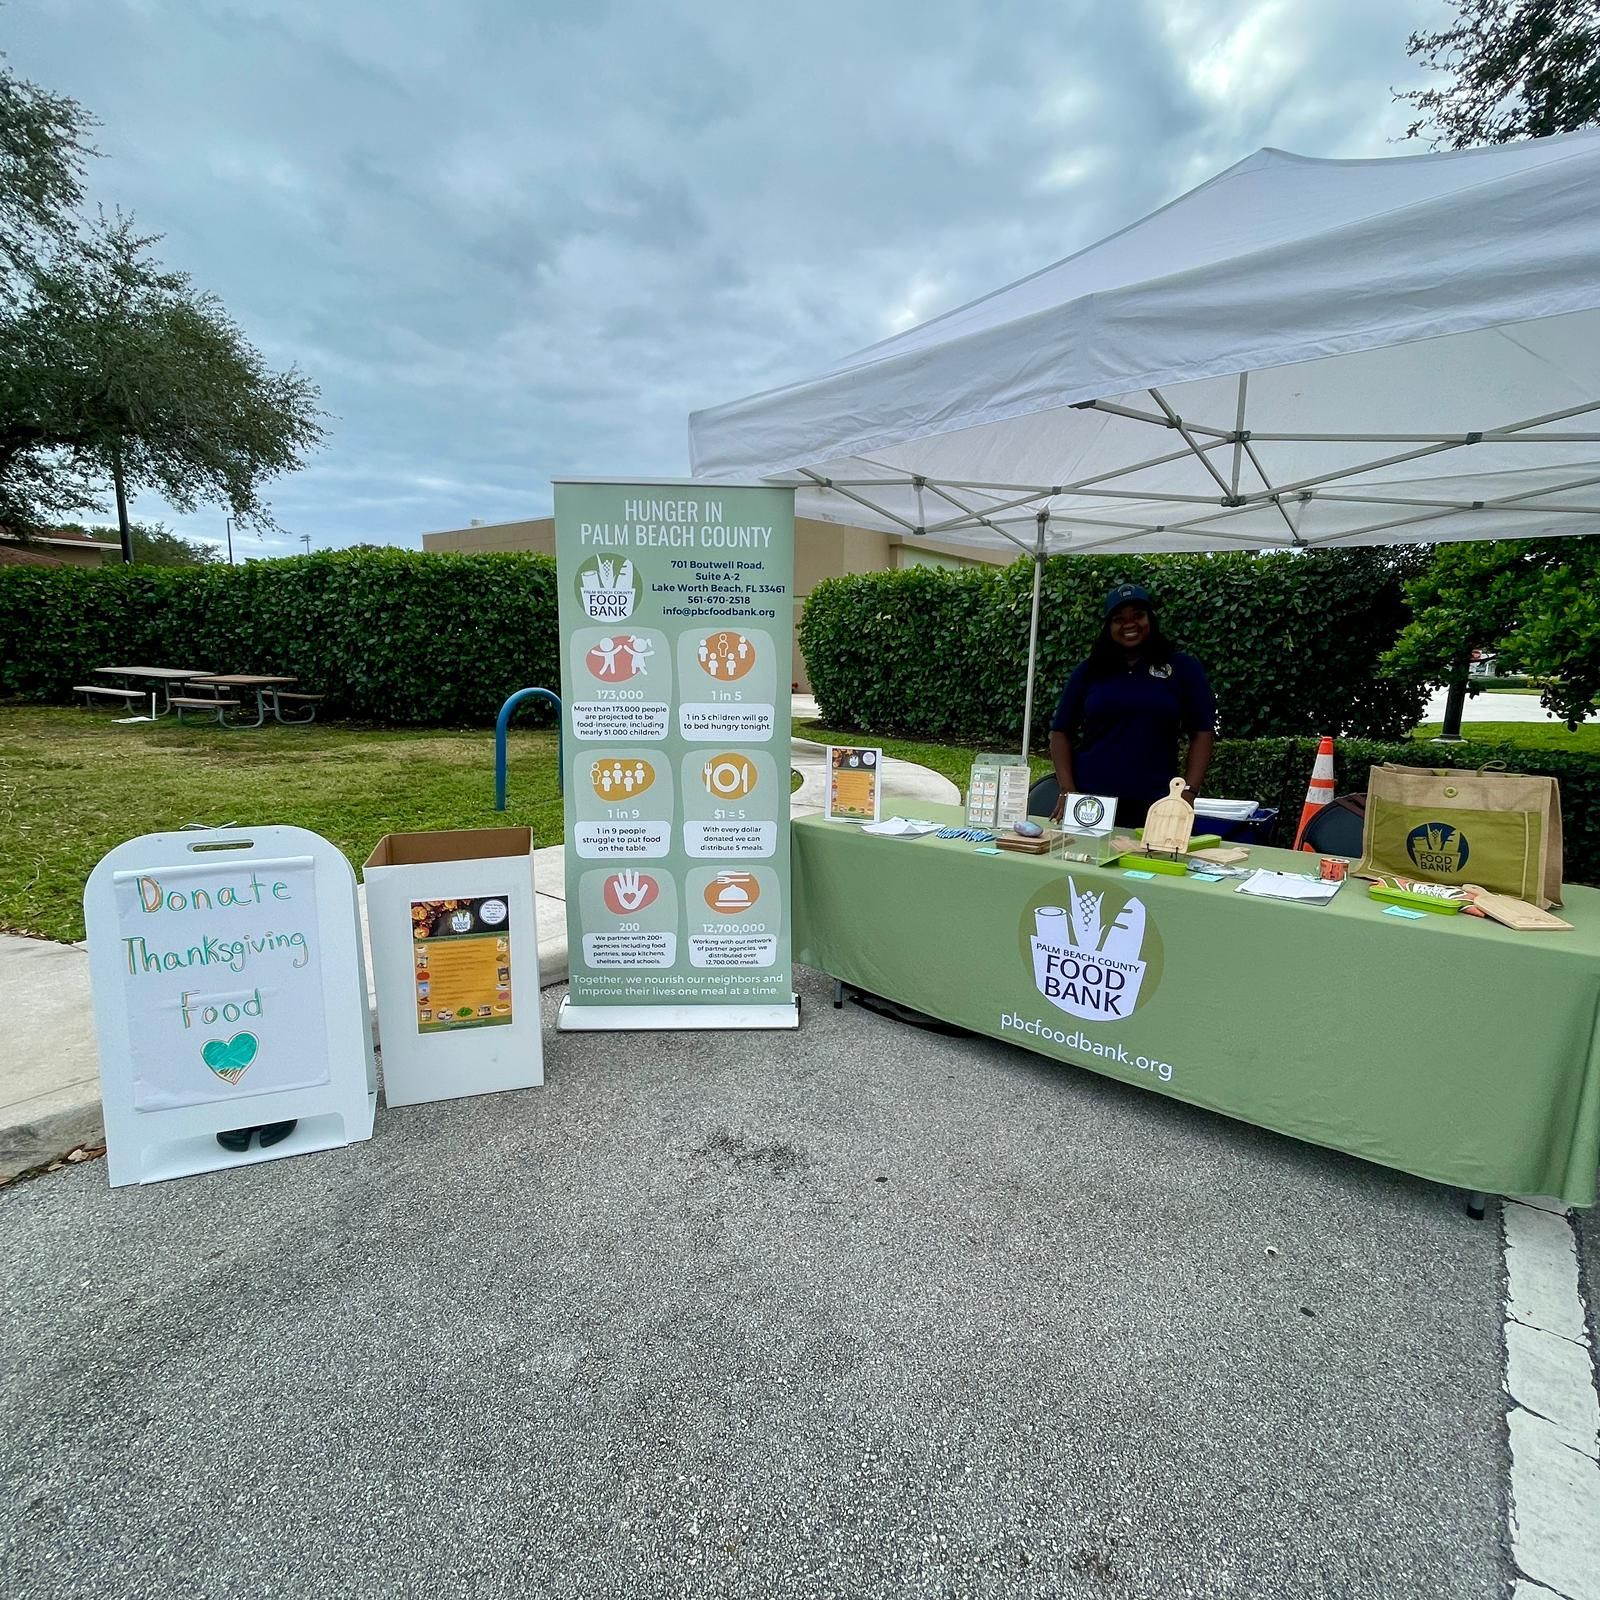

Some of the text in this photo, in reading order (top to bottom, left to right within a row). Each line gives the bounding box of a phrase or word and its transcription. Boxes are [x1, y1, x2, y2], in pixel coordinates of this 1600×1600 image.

[625, 500, 722, 522] HUNGER IN
[581, 524, 772, 547] PALM BEACH COUNTY
[671, 560, 764, 570] 701 Boutwell Road,
[696, 572, 721, 580] Suite
[652, 583, 675, 592] Lake
[678, 584, 708, 592] Worth
[711, 584, 743, 593] Beach,
[759, 585, 785, 593] 33461
[590, 595, 627, 605] FOOD
[688, 596, 750, 604] 561-670-2518
[590, 606, 627, 616] BANK
[663, 606, 775, 618] info@pbcfoodbank.org
[596, 690, 643, 700] 173,000
[712, 690, 742, 701] 1 in 5
[629, 721, 664, 729] including
[608, 808, 640, 819] 1 in 9
[714, 808, 725, 819] $1
[582, 836, 615, 844] struggle
[627, 836, 642, 844] put
[1420, 854, 1453, 864] FOOD
[1420, 862, 1452, 872] BANK
[136, 871, 292, 913] Donate
[619, 922, 640, 932] 200
[703, 924, 766, 934] 12,700,000
[121, 931, 309, 976] Thanksgiving
[1036, 942, 1140, 974] PALM BEACH COUNTY
[1046, 954, 1126, 991] FOOD
[573, 974, 783, 985] Together, we nourish our neighbors and
[579, 987, 622, 997] improve
[625, 987, 650, 995] their
[652, 987, 676, 995] lives
[701, 987, 727, 995] meal
[1044, 975, 1122, 1016] BANK
[181, 987, 263, 1029] Food
[1001, 1012, 1173, 1082] pbcfoodbank.org
